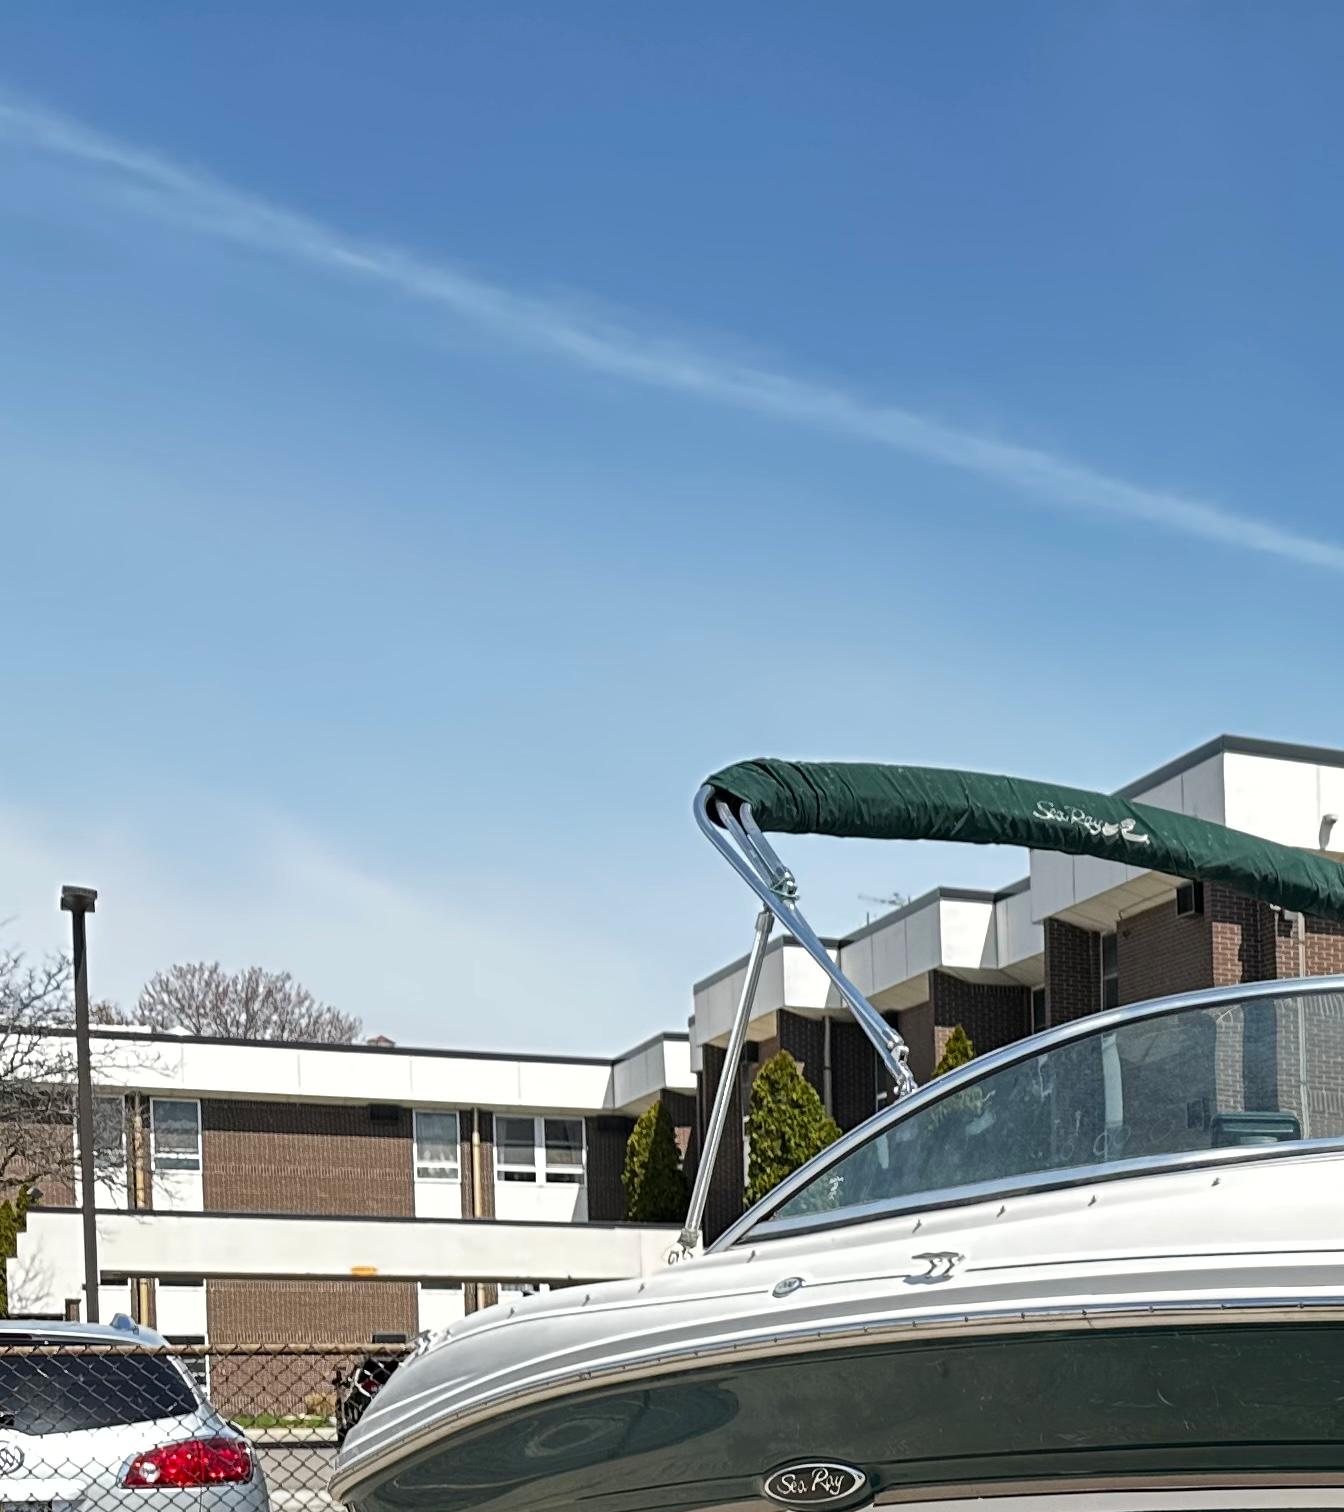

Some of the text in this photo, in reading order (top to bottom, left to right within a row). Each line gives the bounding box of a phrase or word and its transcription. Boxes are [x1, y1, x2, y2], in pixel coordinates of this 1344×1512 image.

[1033, 800, 1102, 835] Sea Ray
[777, 1467, 844, 1495] Sea Ray
